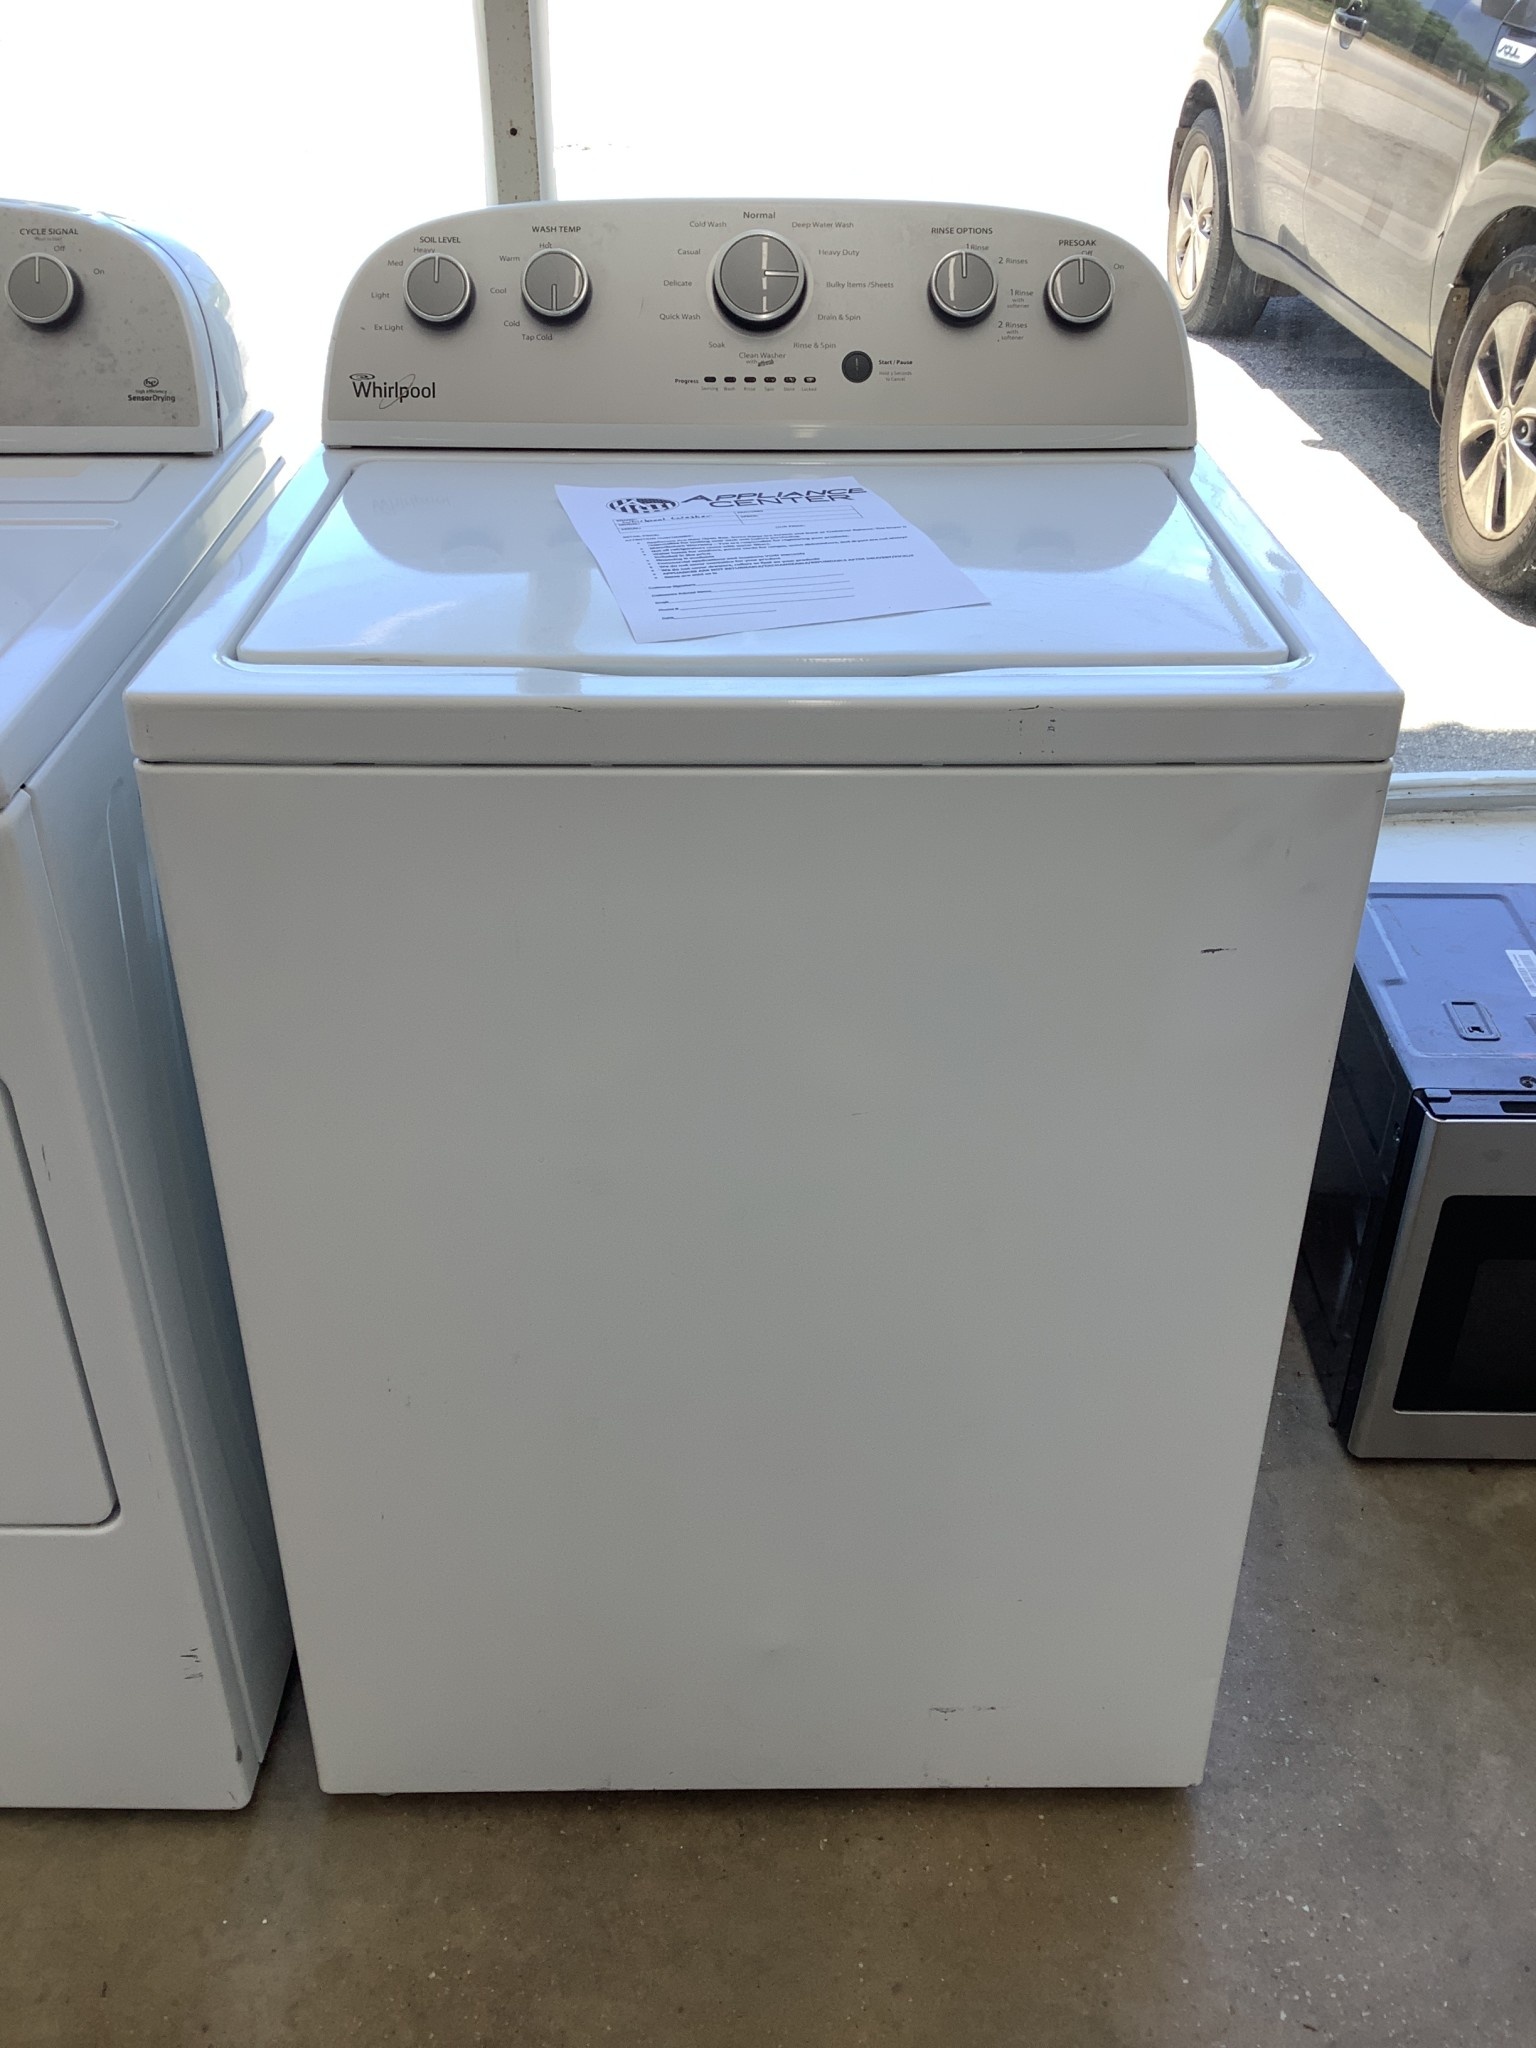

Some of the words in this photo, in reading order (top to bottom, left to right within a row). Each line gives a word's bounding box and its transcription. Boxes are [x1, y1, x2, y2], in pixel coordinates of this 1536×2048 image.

[743, 211, 776, 219] Normal
[791, 221, 811, 229] Deep
[956, 227, 993, 235] OPTIONS
[419, 236, 437, 244] SOIL
[438, 236, 461, 244] LEVEL
[1058, 239, 1097, 247] PRESOAK
[677, 248, 701, 256] Casual
[819, 249, 841, 257] Heavy
[842, 249, 860, 257] Duty
[387, 259, 404, 267] Med
[998, 257, 1004, 265] 2
[1005, 257, 1028, 265] Rinses
[93, 267, 105, 275] On
[826, 281, 846, 289] Bulky
[846, 281, 867, 289] Items
[371, 291, 390, 300] Light
[844, 314, 861, 322] Spin
[384, 324, 404, 332] Light
[997, 320, 1003, 328] 2
[1005, 321, 1028, 329] Rinses
[521, 334, 534, 342] Tap
[535, 333, 553, 341] Cold
[708, 341, 725, 349] Soak
[820, 342, 837, 350] Spin
[738, 351, 759, 359] Clean
[760, 351, 786, 359] Washer
[352, 381, 436, 403] Whirlpool
[128, 394, 176, 403] SensorDrying
[681, 487, 868, 503] APPLIANCE
[709, 494, 855, 508] CENTER
